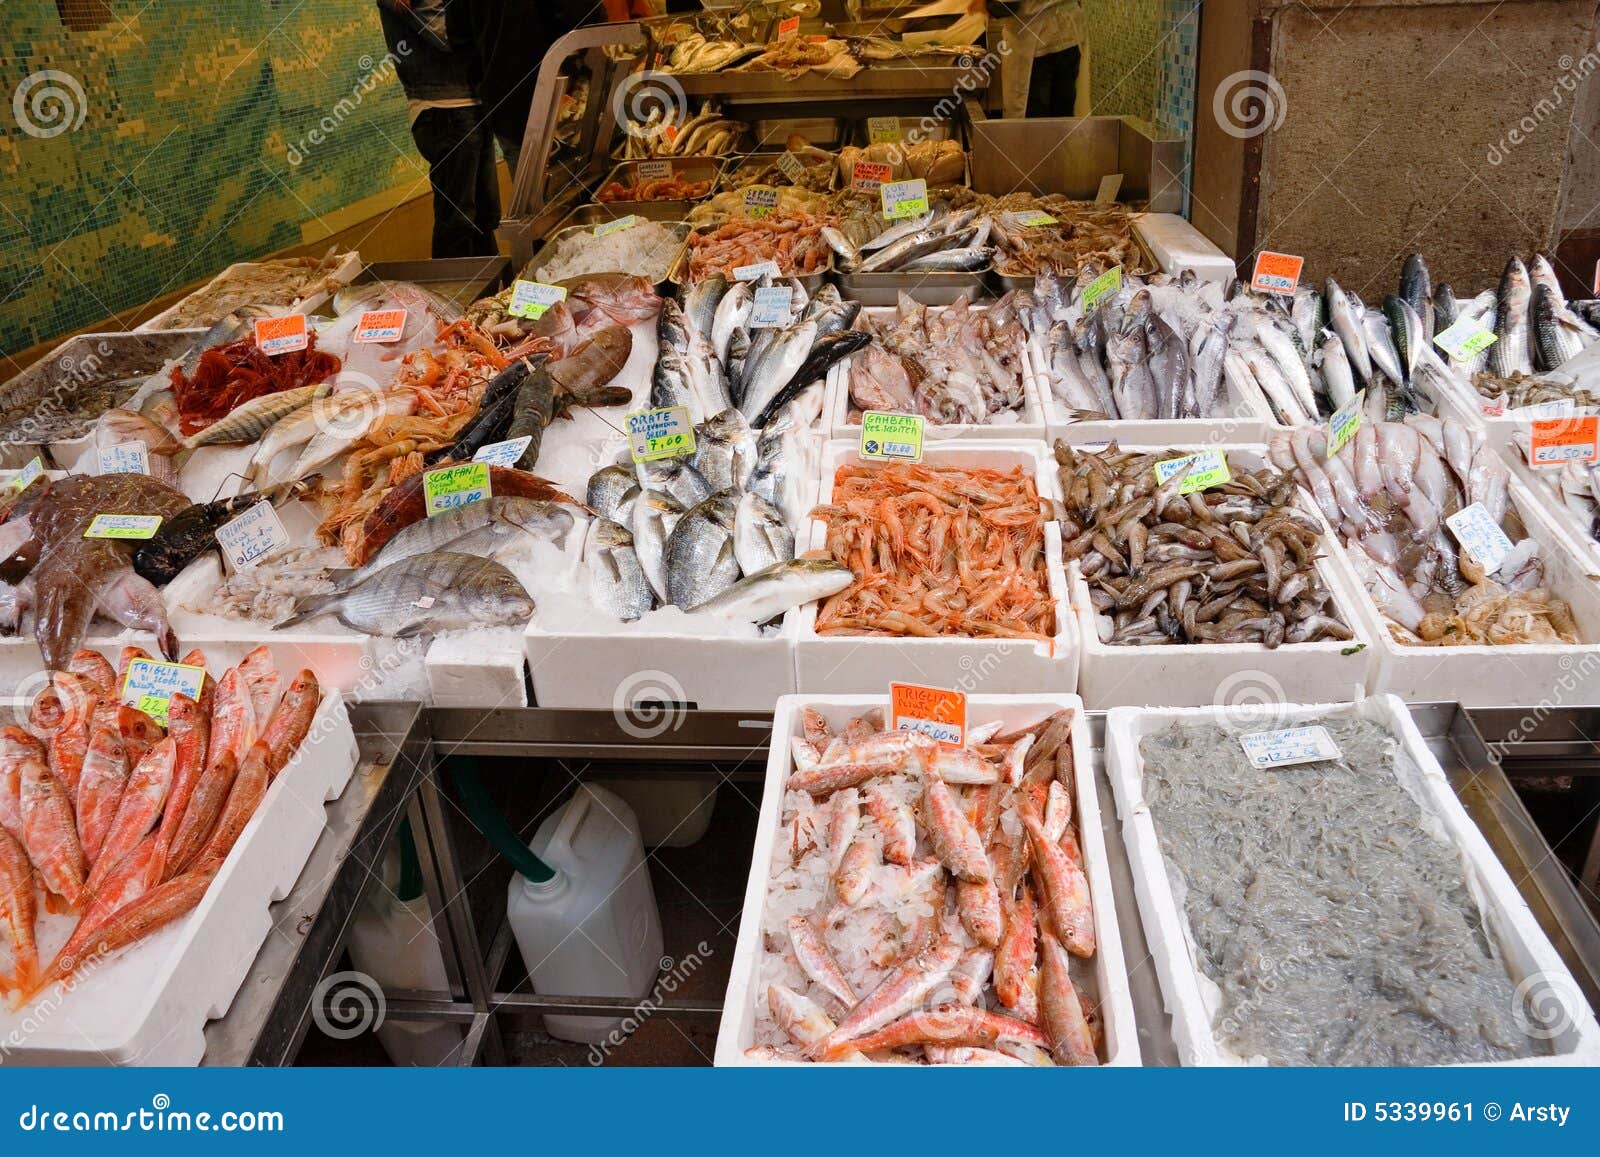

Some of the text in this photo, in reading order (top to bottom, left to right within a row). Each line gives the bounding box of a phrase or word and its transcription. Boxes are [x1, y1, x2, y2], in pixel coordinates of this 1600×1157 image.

[746, 188, 777, 200] SEPPIA
[629, 411, 672, 427] ORATE
[866, 414, 917, 427] GAMBERI
[649, 435, 683, 451] 7,00
[428, 465, 480, 484] SCORFANI
[133, 661, 179, 678] TRIGLIA
[154, 675, 188, 687] SCOGLIO
[949, 732, 960, 744] Kg
